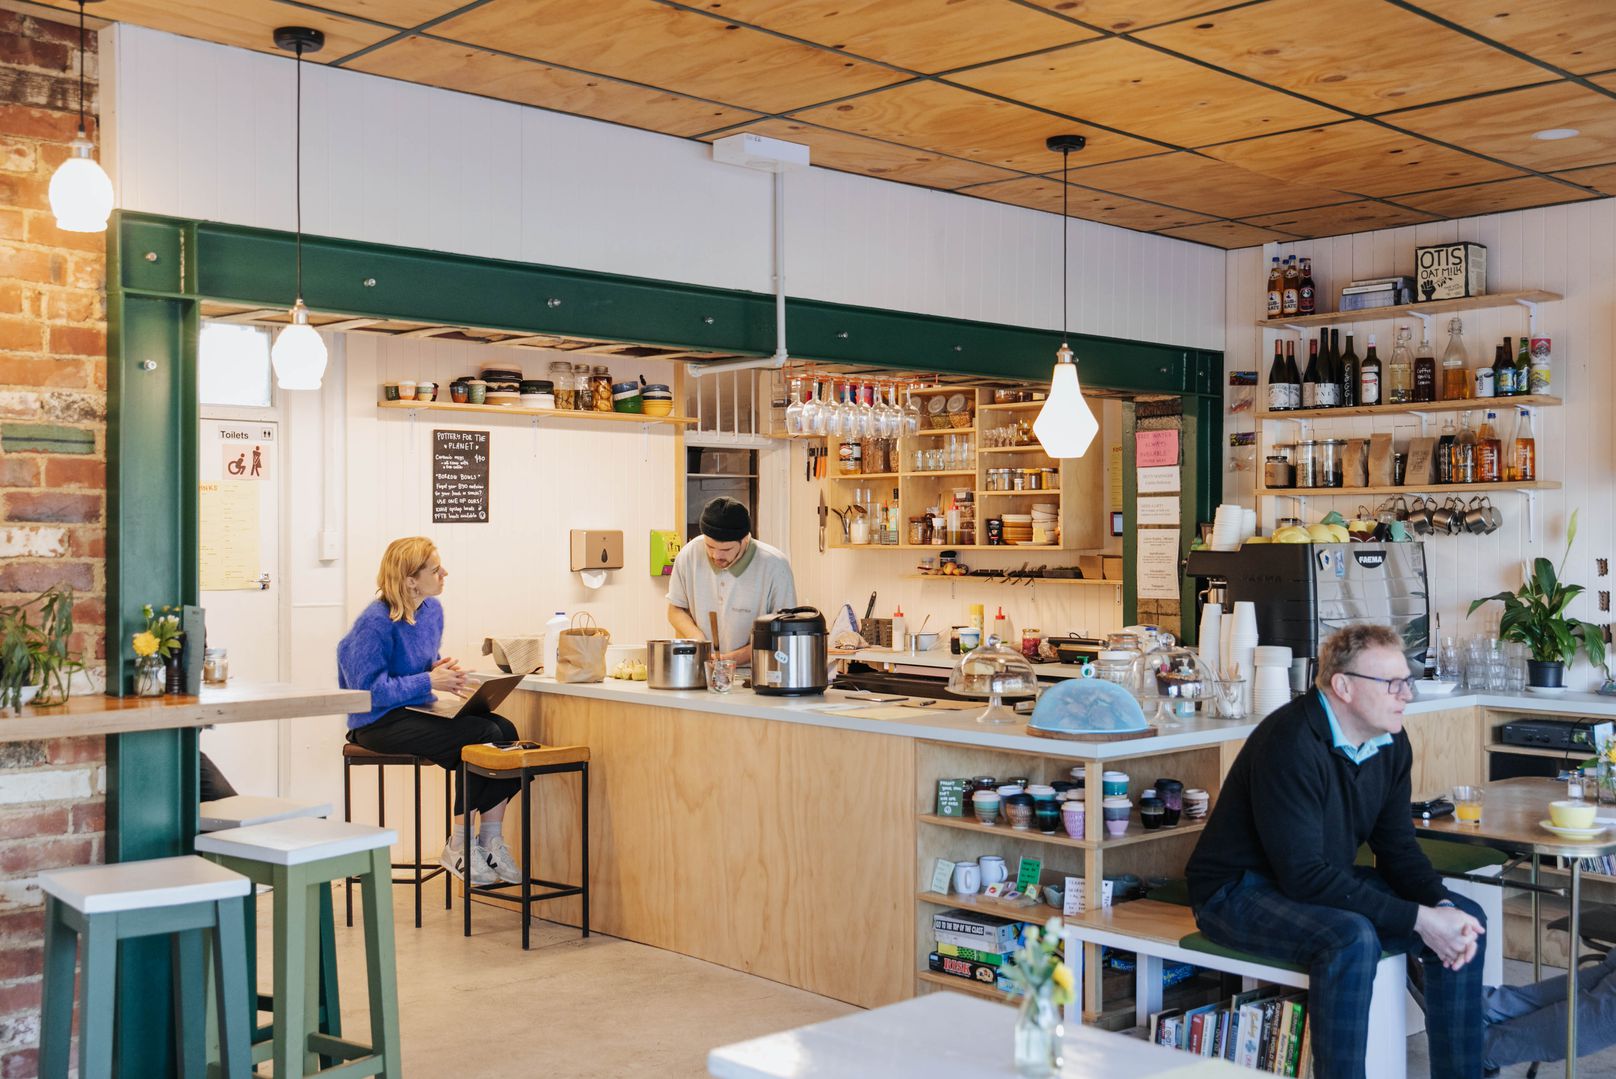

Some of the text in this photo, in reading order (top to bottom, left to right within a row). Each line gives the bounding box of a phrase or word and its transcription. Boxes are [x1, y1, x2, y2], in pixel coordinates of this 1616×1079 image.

[1420, 248, 1463, 269] OTIS
[1421, 268, 1440, 280] OAT
[1441, 265, 1463, 277] MILK
[220, 430, 249, 439] Toilets
[437, 432, 486, 442] POTTERY FOR THE
[448, 442, 474, 450] PLANET
[1358, 555, 1383, 564] FAEMA
[935, 920, 941, 928] GO
[942, 921, 947, 929] TO
[960, 924, 965, 932] OF
[971, 926, 984, 935] CLASS
[943, 958, 972, 976] RISK
